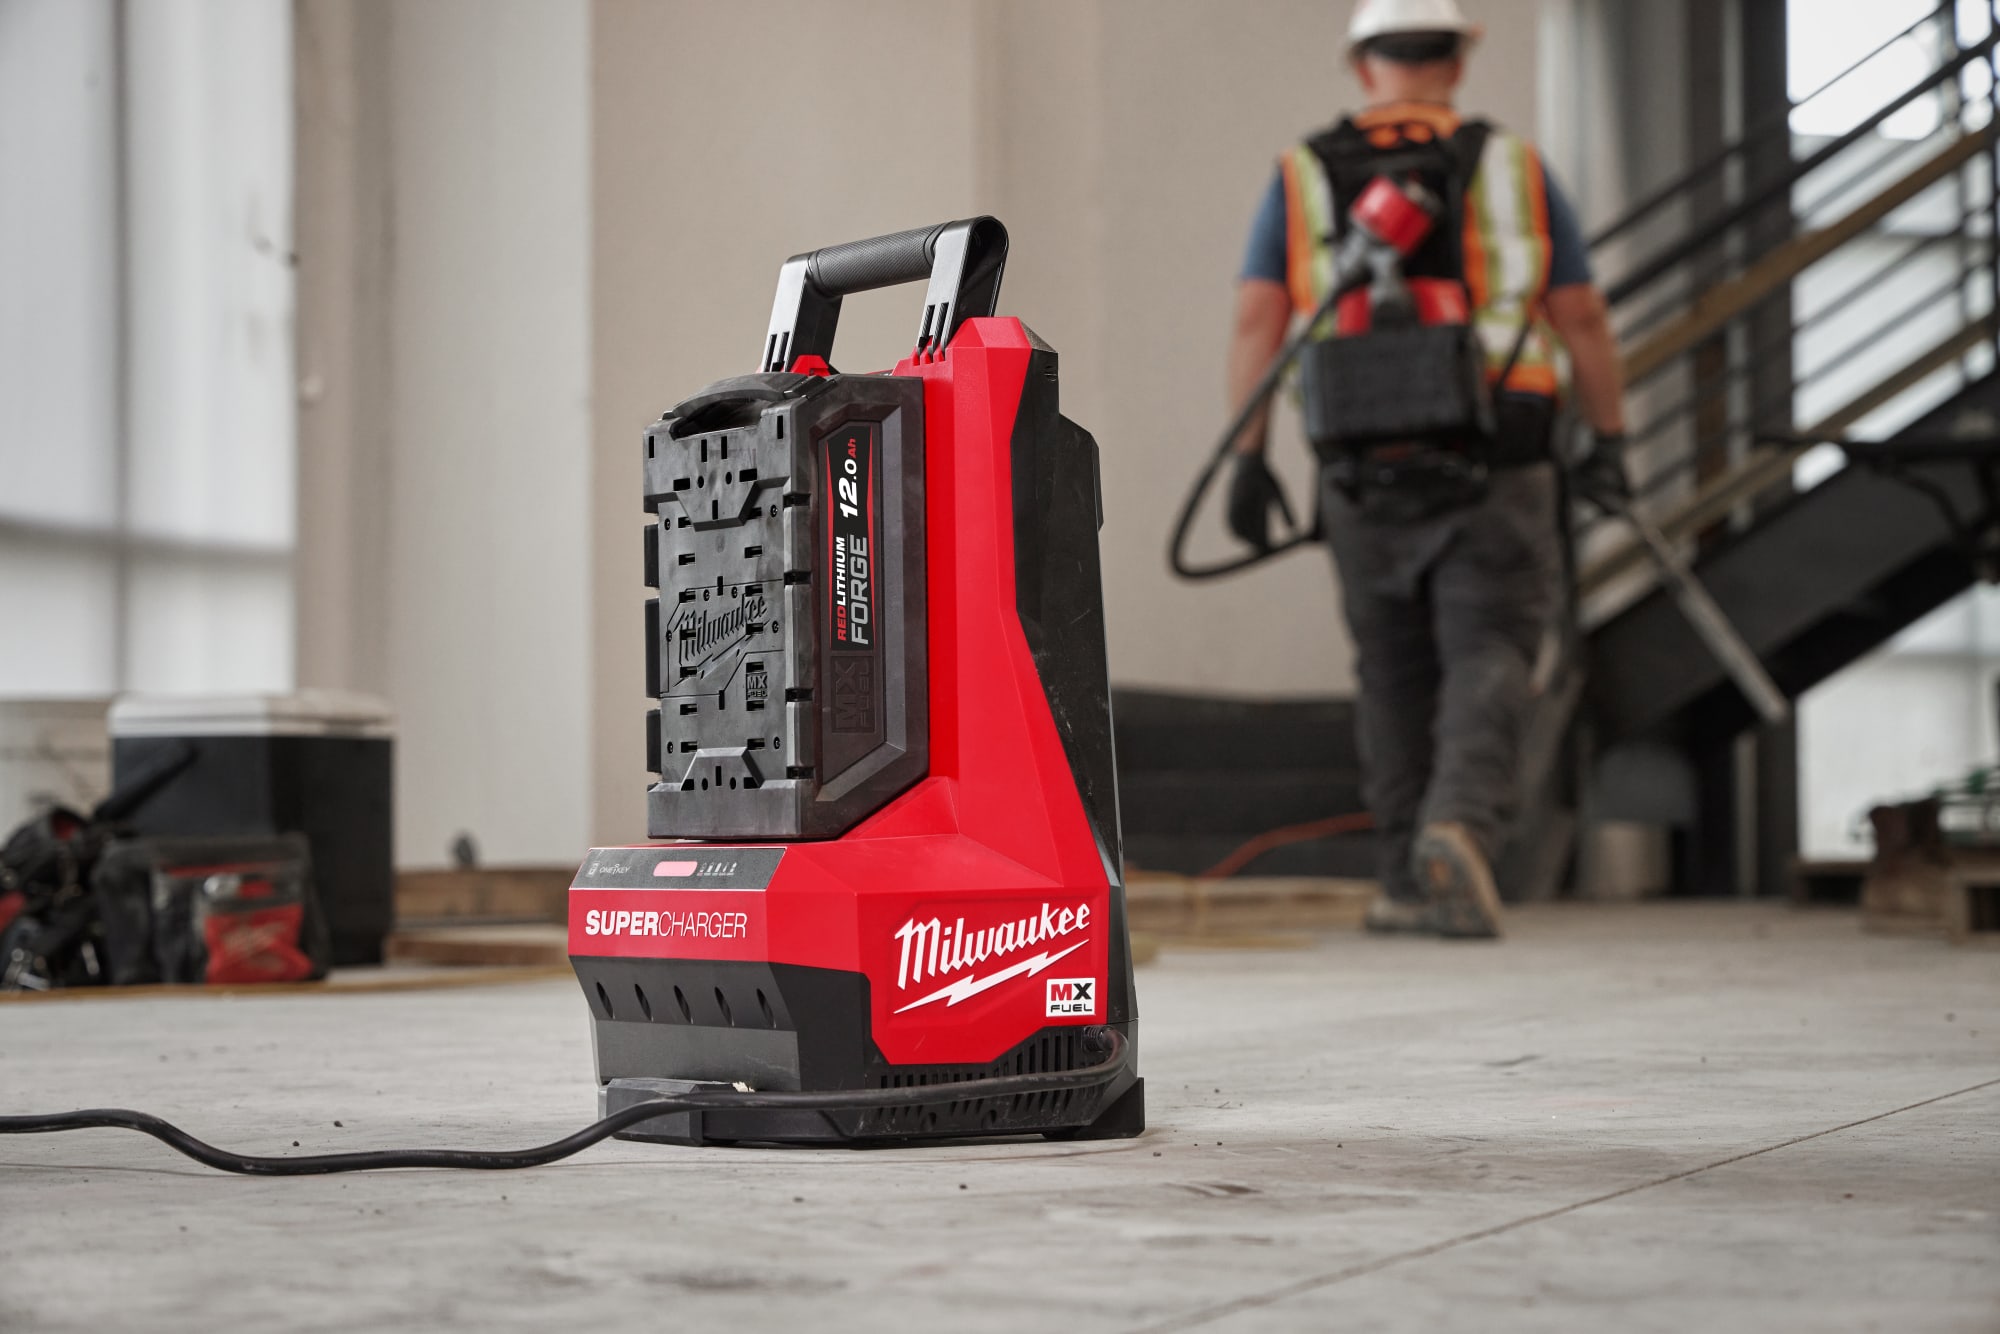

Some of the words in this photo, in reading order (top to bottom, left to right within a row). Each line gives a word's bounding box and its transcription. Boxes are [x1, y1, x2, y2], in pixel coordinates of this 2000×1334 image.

[836, 536, 847, 641] REDLITHIUM
[850, 534, 869, 645] FORGE
[585, 909, 748, 938] SUPERCHARGER
[894, 903, 1091, 990] Milwaukee
[1050, 982, 1093, 1001] MX
[1050, 1003, 1093, 1013] FUEL
